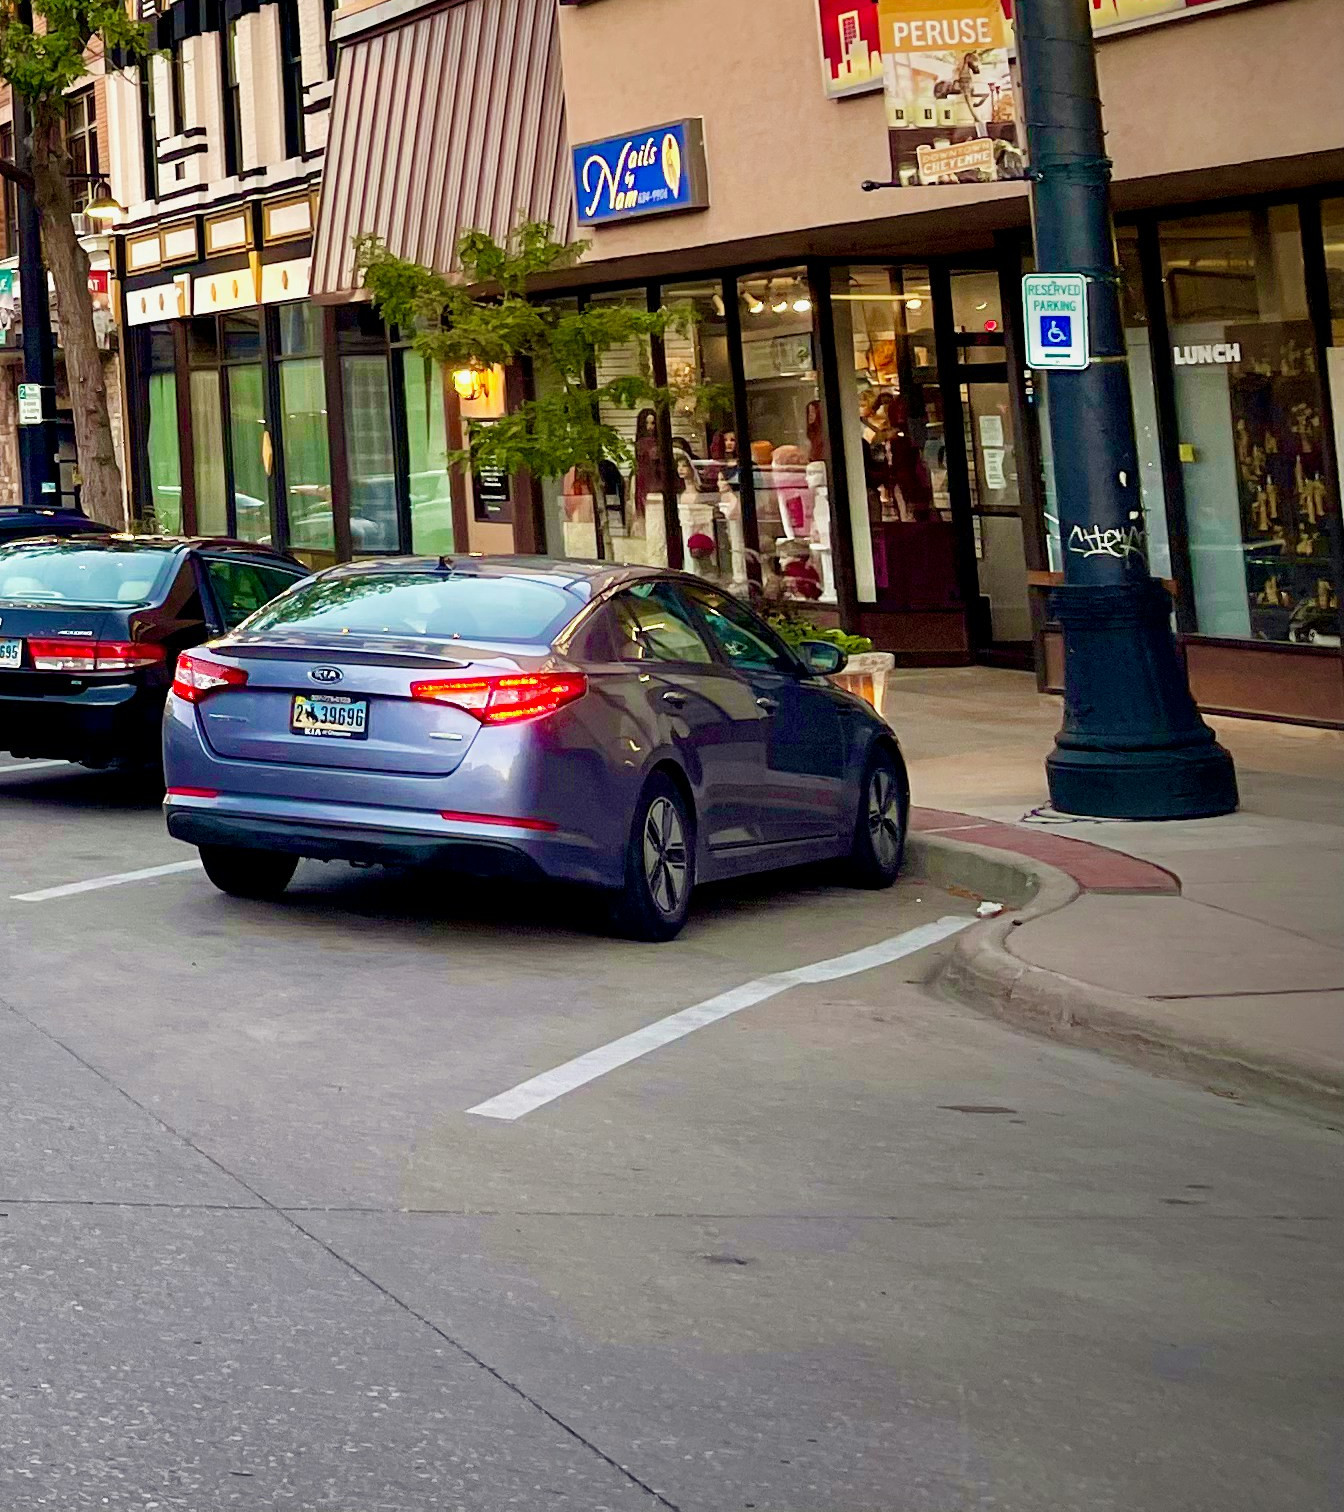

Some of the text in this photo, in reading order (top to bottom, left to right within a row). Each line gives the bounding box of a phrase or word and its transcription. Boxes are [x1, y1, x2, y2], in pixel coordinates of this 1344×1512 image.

[892, 17, 993, 48] PERUSE
[922, 141, 991, 164] DOWNTOWN
[923, 150, 991, 174] CHEYENNE
[582, 137, 658, 217] Nails
[1027, 284, 1081, 296] RESERVED
[1033, 300, 1076, 312] PARKING
[1173, 343, 1241, 365] LUNCH
[314, 670, 336, 680] KIA
[295, 704, 364, 727] 2 39696
[305, 728, 321, 736] KIA
